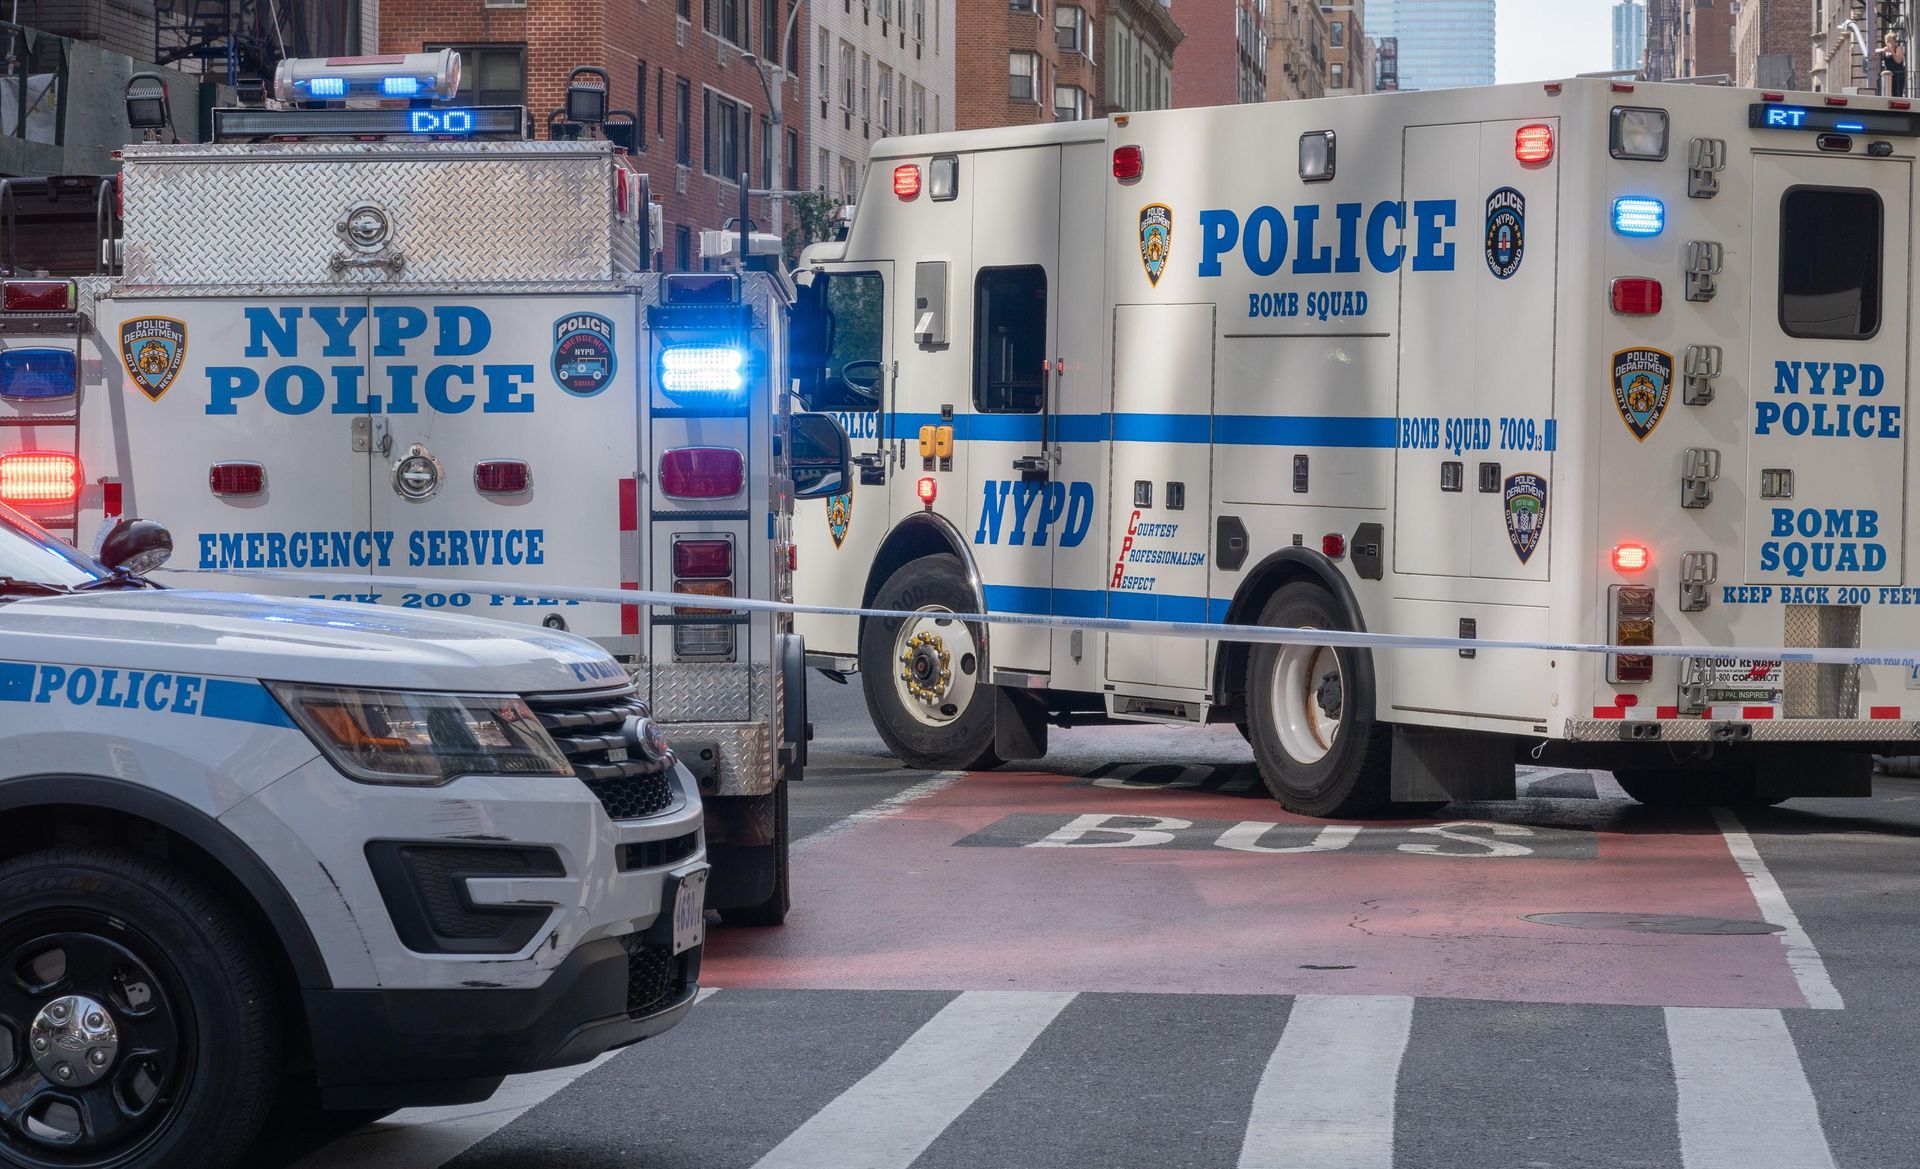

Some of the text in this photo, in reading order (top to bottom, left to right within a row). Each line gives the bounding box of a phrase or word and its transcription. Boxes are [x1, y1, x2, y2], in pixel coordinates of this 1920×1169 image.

[412, 111, 471, 132] DO
[1768, 109, 1805, 126] RT
[1146, 208, 1165, 218] POLICE
[1488, 192, 1523, 218] POLICE
[1496, 213, 1514, 226] NYPD
[1198, 199, 1457, 278] POLICE
[1486, 248, 1522, 276] BOMB SQUAD
[1249, 290, 1368, 321] BOMB SQUAD
[124, 328, 183, 344] DEPARTMENT
[136, 320, 171, 330] POLICE
[244, 306, 492, 358] NYPD
[558, 316, 610, 339] POLICE
[560, 335, 609, 354] EMERGENCY
[574, 348, 595, 356] NYPD
[1627, 352, 1660, 363] POLICE
[125, 353, 147, 386] CITY OF
[159, 348, 183, 389] NEW YORK
[1615, 361, 1670, 378] DEPARTMENT
[1774, 360, 1884, 396] NYPD
[205, 364, 534, 416] POLICE
[1616, 388, 1635, 425] CITY OF
[1645, 384, 1670, 430] NEW YORK
[1755, 402, 1901, 438] POLICE
[1402, 417, 1440, 449] BOMB
[1445, 417, 1491, 456] SQUAD
[1506, 484, 1544, 500] DEPARTMENT
[1514, 476, 1536, 486] POLICE
[974, 480, 1094, 548] NYPD
[1128, 510, 1178, 538] COURTESY
[1506, 510, 1518, 545] CITY OF
[1771, 508, 1878, 538] BOMB
[1530, 507, 1545, 550] NEW YORK
[199, 529, 544, 568] EMERGENCY SERVICE
[1119, 536, 1206, 566] PROFESSIONALISM
[1760, 542, 1887, 577] SQUAD
[1111, 563, 1156, 590] RESPECT
[402, 592, 471, 608] 200
[1722, 586, 1773, 604] KEEP
[1780, 587, 1829, 604] BACK
[1838, 587, 1871, 605] 200
[1740, 659, 1782, 668] REWARD
[35, 665, 202, 715] POLICE
[1725, 691, 1769, 699] PAL INSPIRES
[1025, 812, 1534, 858] BUS
